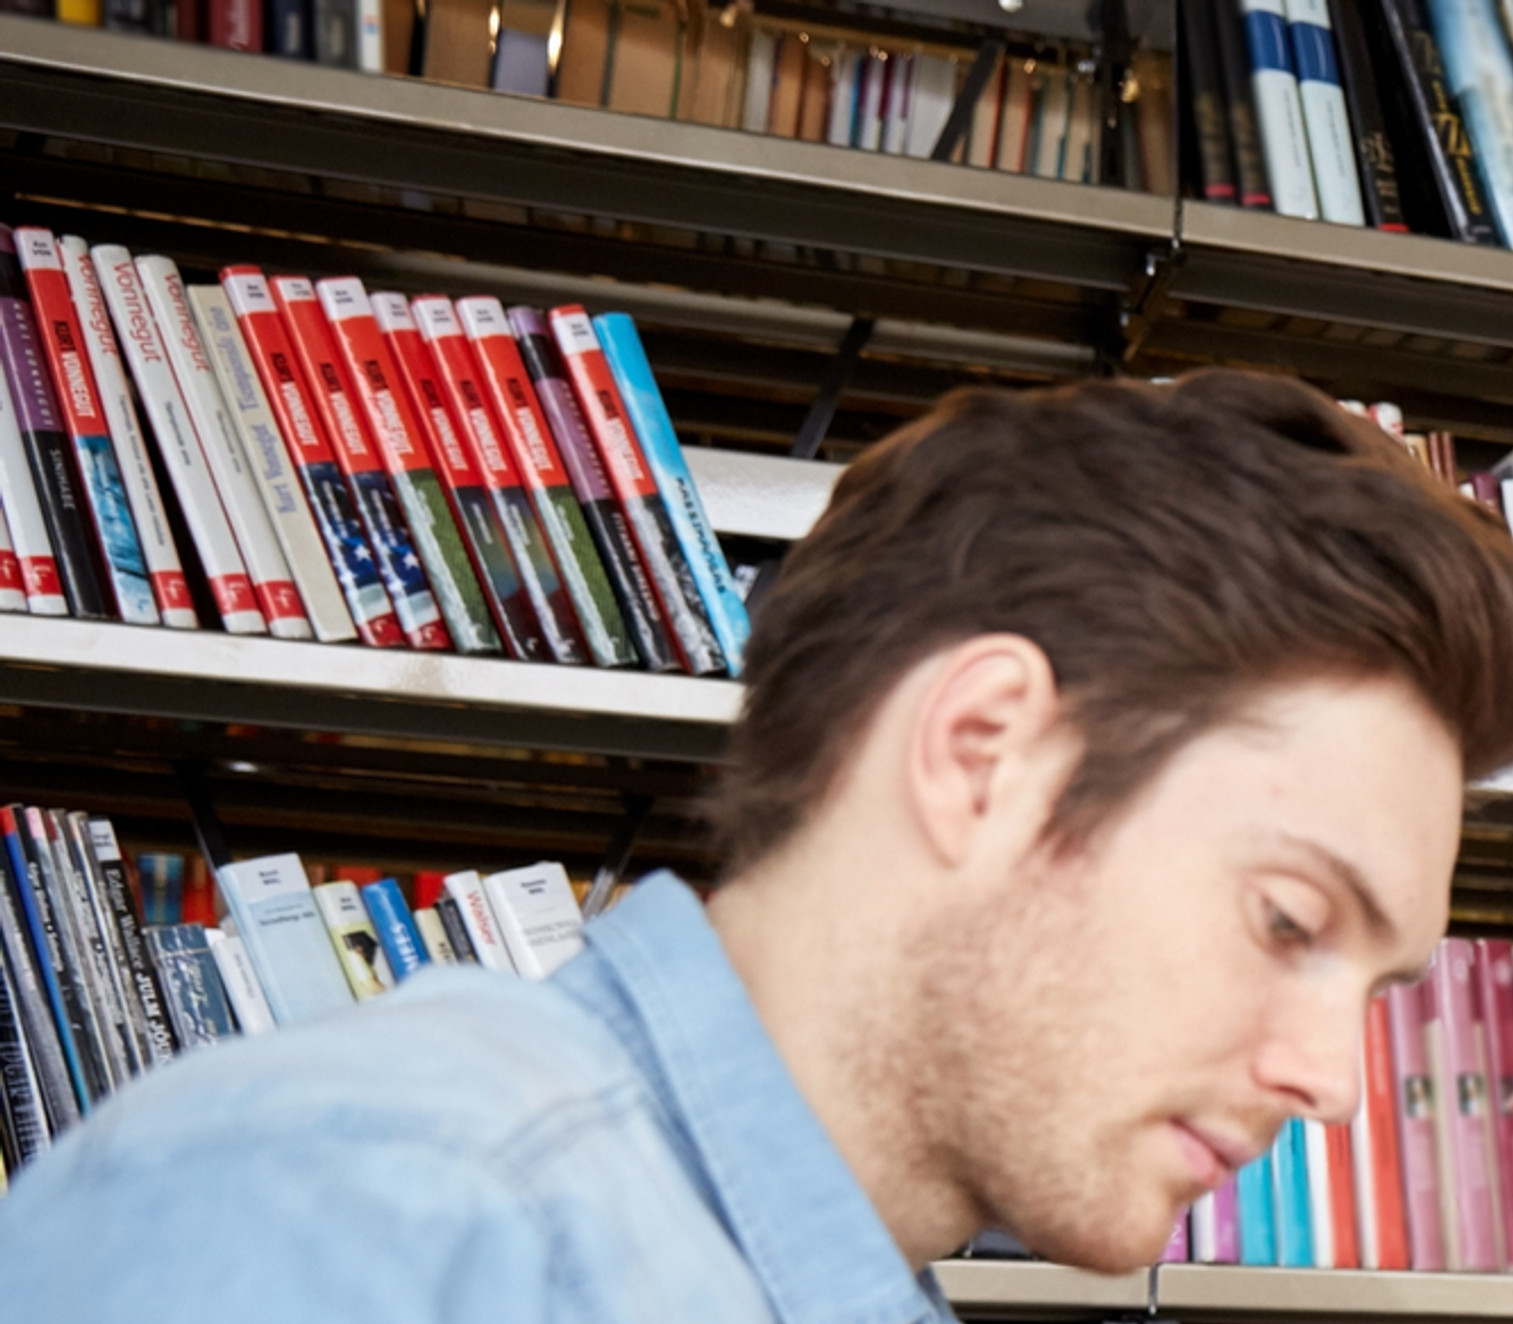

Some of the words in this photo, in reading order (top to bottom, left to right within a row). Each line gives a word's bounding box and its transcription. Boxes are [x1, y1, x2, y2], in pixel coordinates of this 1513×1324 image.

[52, 320, 76, 352] KURT
[77, 253, 118, 356] Vonnegut
[114, 261, 162, 363] Vonnegut
[164, 274, 211, 373] Vonnegut
[61, 351, 96, 418] VONNEGUT
[105, 867, 127, 914] Edgar
[118, 913, 145, 978] Wallace
[136, 973, 161, 1019] JULM
